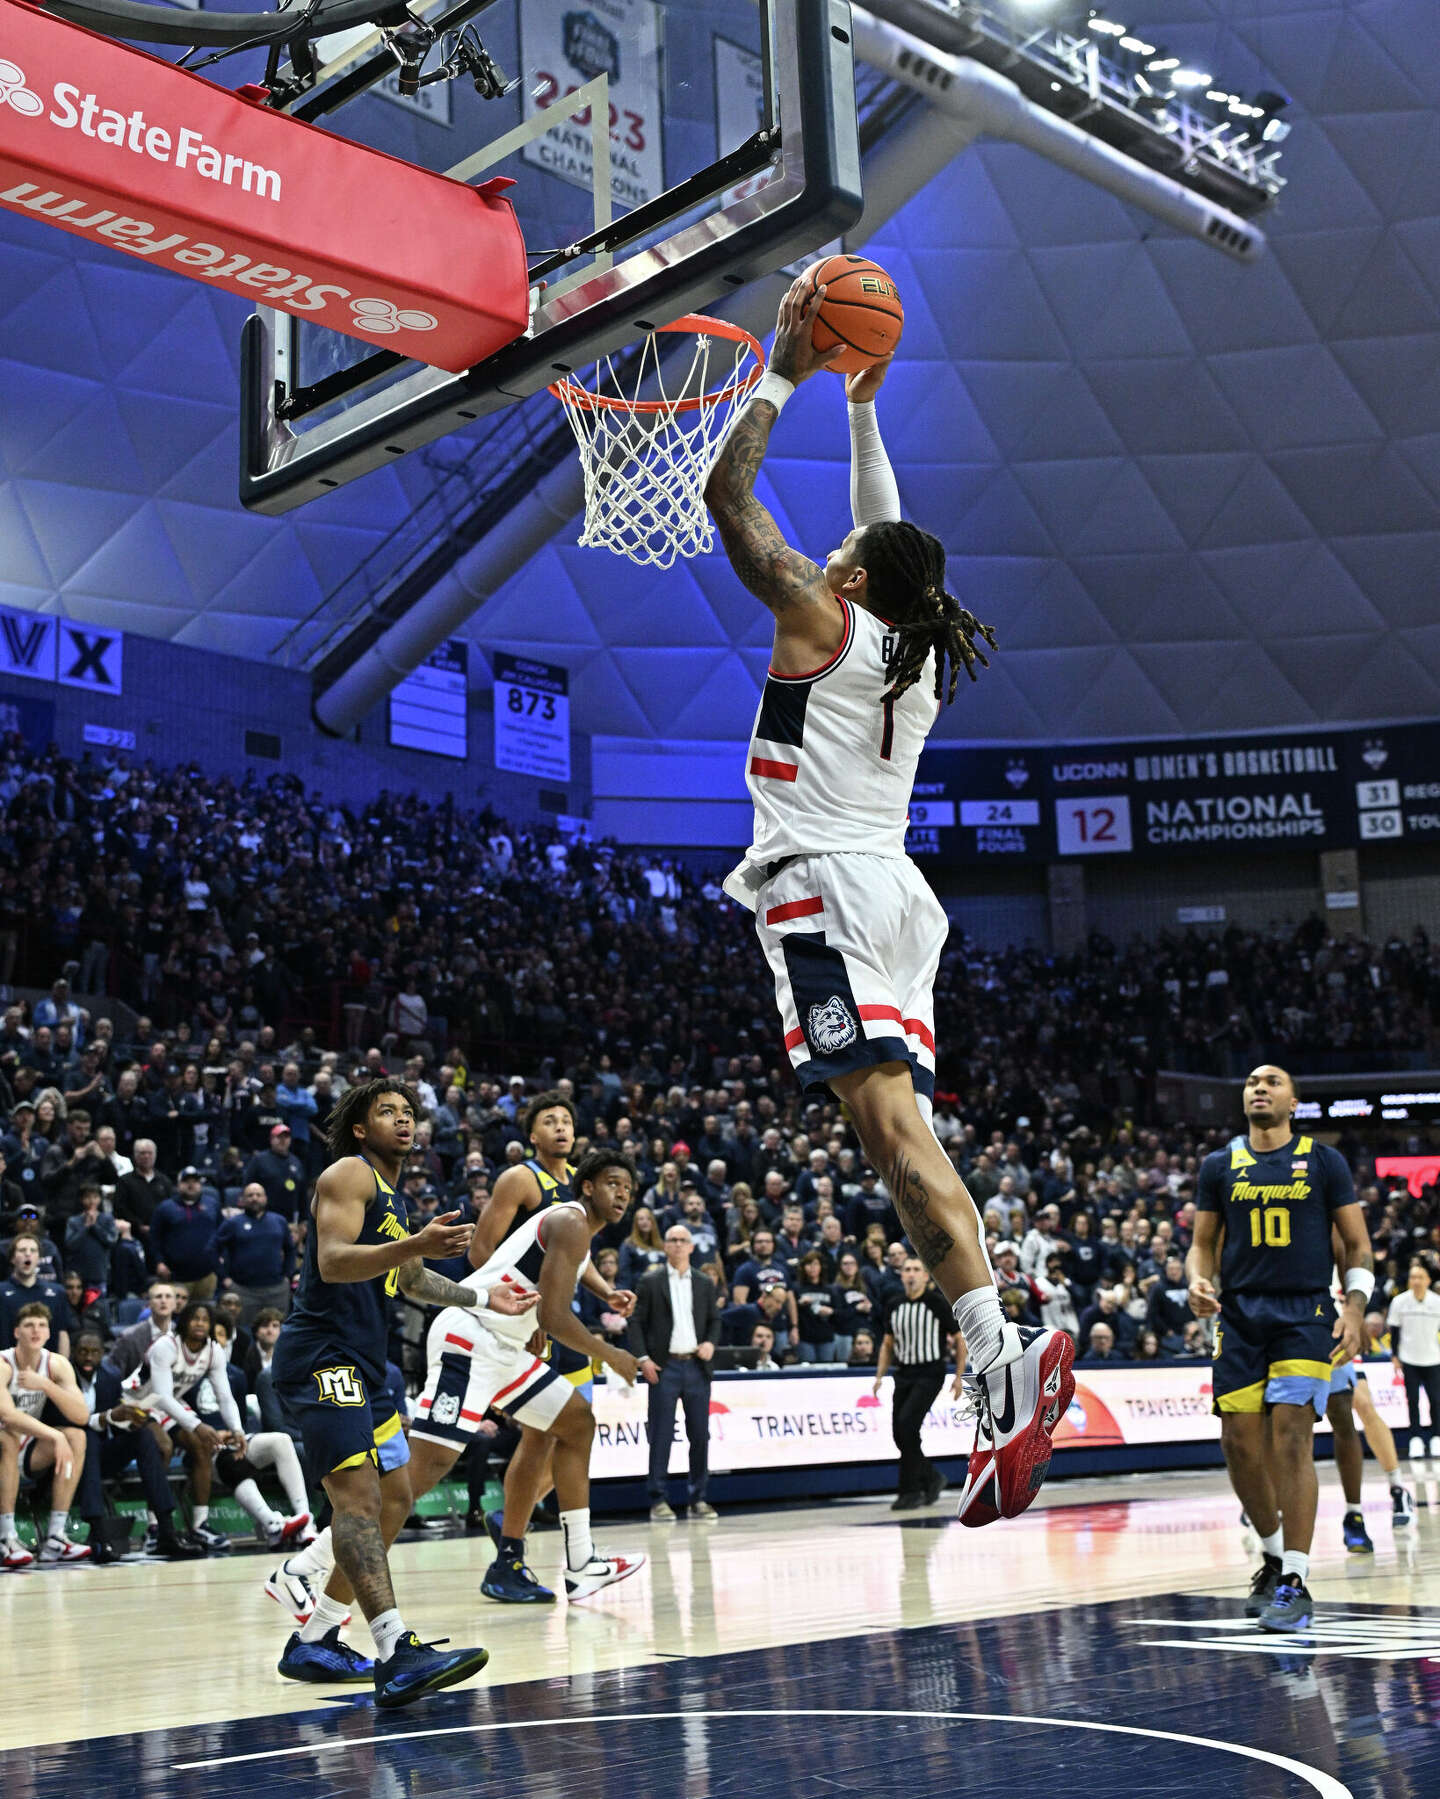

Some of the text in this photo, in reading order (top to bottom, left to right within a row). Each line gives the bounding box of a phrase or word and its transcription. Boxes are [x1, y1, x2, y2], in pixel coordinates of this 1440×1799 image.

[67, 628, 113, 685] X
[508, 688, 556, 720] 873
[1053, 763, 1128, 781] UCONN
[1223, 747, 1338, 776] BASKETBALL
[987, 805, 1013, 821] 24
[1146, 793, 1322, 825] NATIONAL
[1367, 814, 1396, 834] 30
[1072, 809, 1117, 842] 12
[1148, 817, 1326, 844] CHAMPIONSHIPS
[1231, 1180, 1312, 1205] Marquette
[1250, 1208, 1291, 1247] 10
[313, 1366, 366, 1407] MU
[752, 1412, 867, 1438] TRAVELERS
[1126, 1397, 1209, 1419] TRAVELERS
